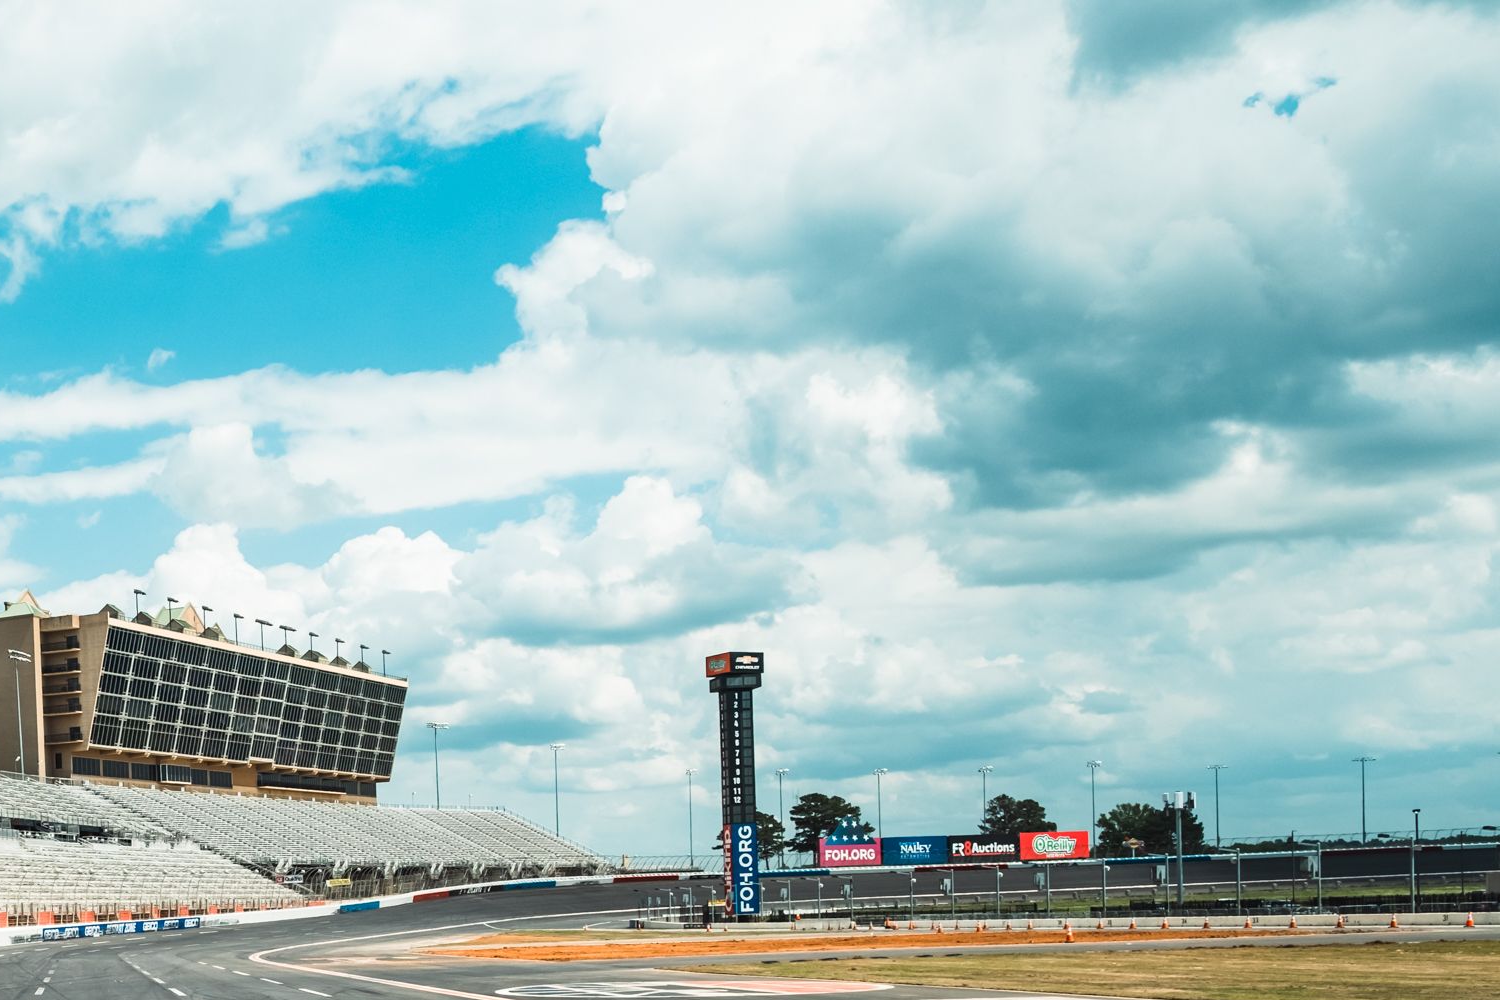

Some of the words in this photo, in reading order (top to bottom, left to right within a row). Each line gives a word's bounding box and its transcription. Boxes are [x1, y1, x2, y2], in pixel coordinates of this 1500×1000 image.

[733, 711, 739, 719] 3
[734, 730, 740, 738] 5
[735, 749, 740, 757] 7
[733, 787, 741, 795] 11
[733, 796, 741, 804] 12
[1033, 834, 1075, 854] O'Reilly
[825, 849, 876, 861] FOH.ORG
[738, 825, 755, 913] FOH.ORG
